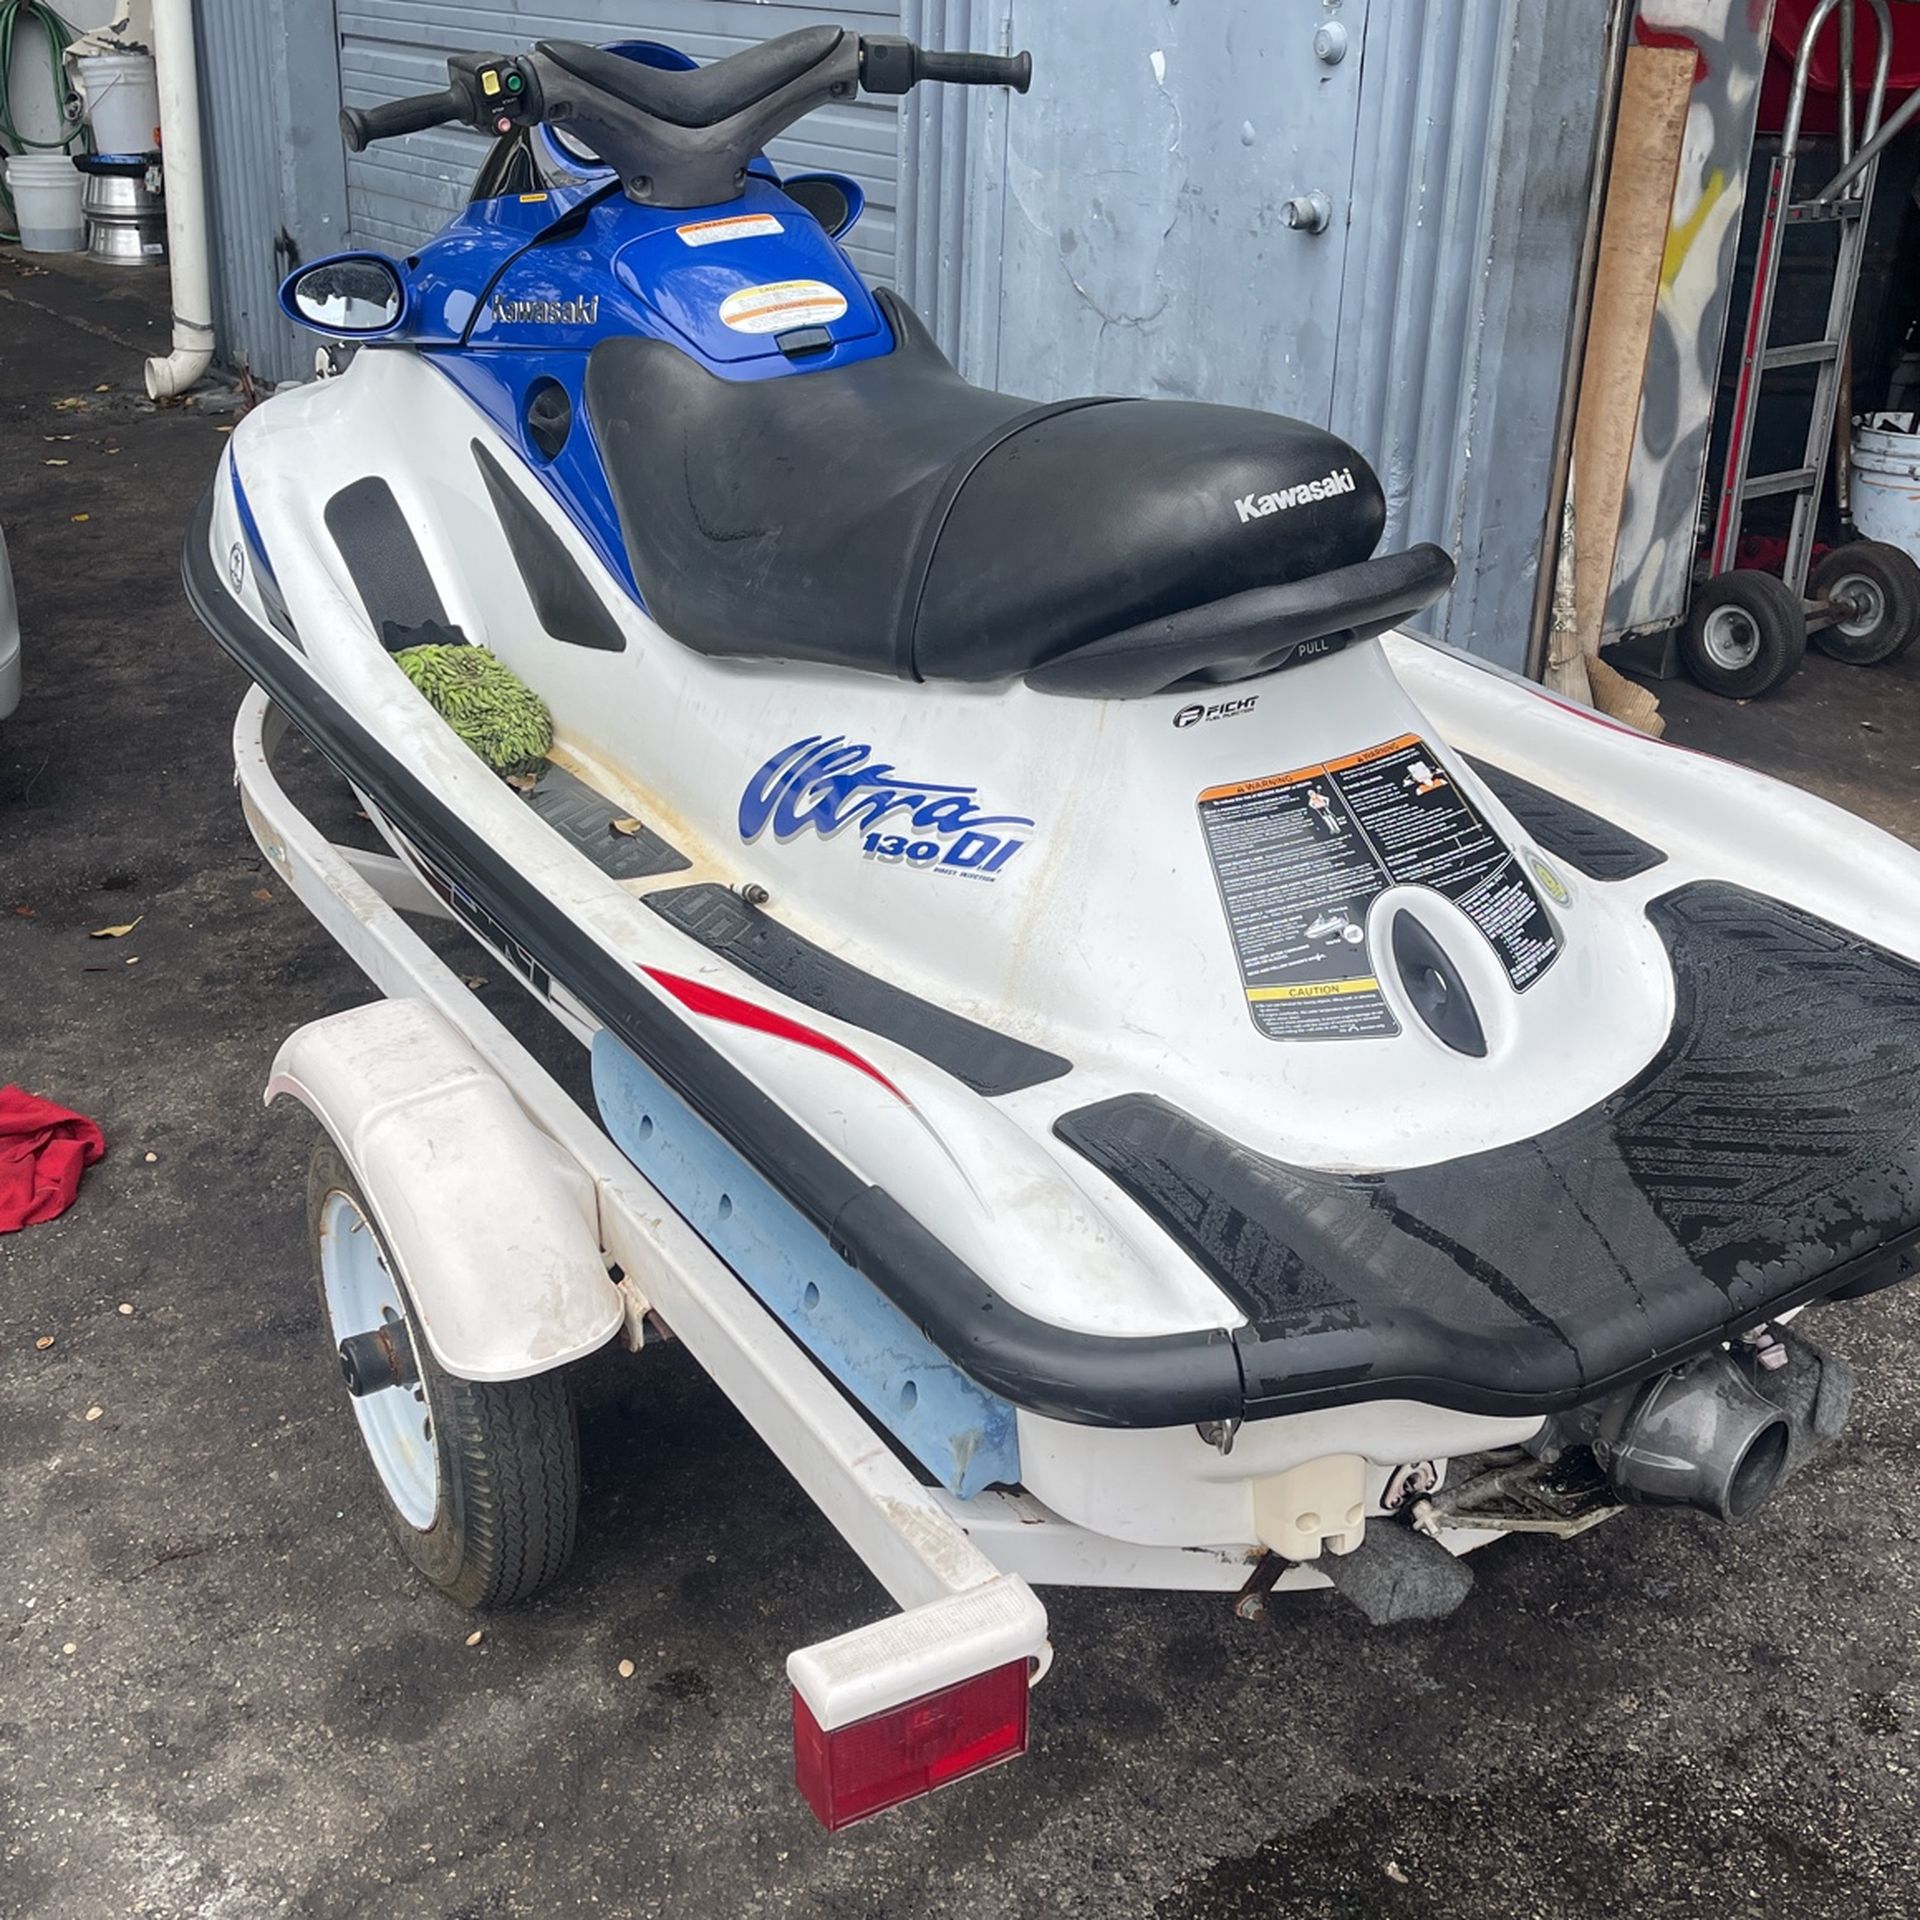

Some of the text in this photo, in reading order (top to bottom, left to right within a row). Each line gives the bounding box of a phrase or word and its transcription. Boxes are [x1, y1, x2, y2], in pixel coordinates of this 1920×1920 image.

[492, 294, 599, 324] Kawasaki
[1234, 468, 1356, 523] Kawasaki
[1299, 639, 1329, 657] PULL
[1207, 695, 1259, 716] FICHT
[738, 736, 1036, 842] Ultra
[1244, 775, 1294, 791] WARNING
[863, 832, 941, 861] 130
[1288, 984, 1341, 998] CAUTION
